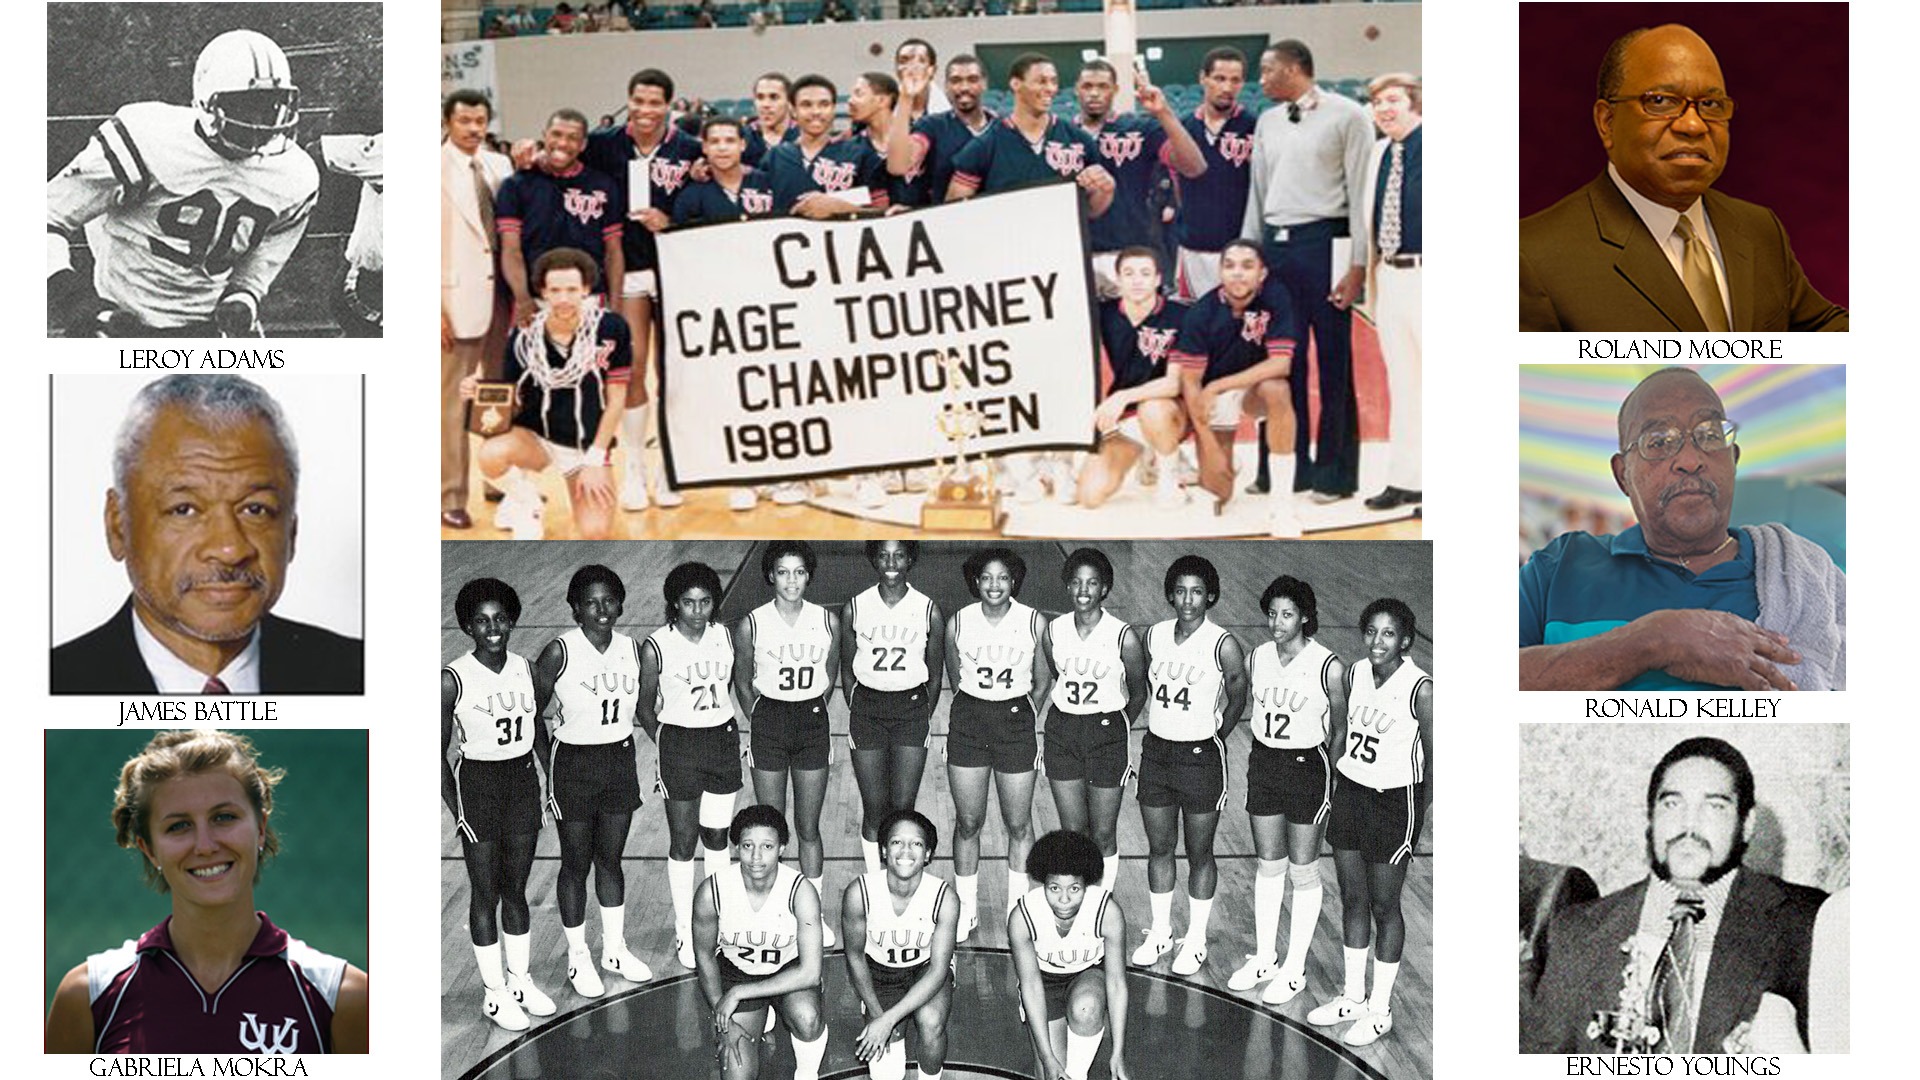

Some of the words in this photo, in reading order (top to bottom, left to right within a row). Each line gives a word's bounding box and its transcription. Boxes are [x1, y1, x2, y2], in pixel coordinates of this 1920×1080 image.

[147, 188, 280, 276] 90
[772, 219, 945, 289] CIAA
[675, 301, 801, 359] CAGE
[834, 271, 1059, 344] TOURNEY
[737, 339, 1013, 413] CHAMPIONS
[723, 416, 832, 464] 1980
[860, 625, 919, 644] VUU
[767, 643, 825, 665] VUU
[872, 647, 907, 672] 22
[965, 645, 1025, 667] VUU
[674, 661, 728, 685] VUU
[778, 666, 815, 691] 30
[976, 666, 1014, 690] 34
[1055, 657, 1111, 681] VUU
[580, 672, 635, 696] VUU
[1065, 681, 1099, 706] 32
[473, 691, 534, 717] VUU
[690, 683, 721, 712] 21
[1155, 683, 1192, 712] 44
[1254, 687, 1309, 713] VUU
[601, 698, 620, 726] 11
[495, 716, 523, 746] 31
[1264, 712, 1291, 740] 12
[1350, 731, 1380, 765] 25
[738, 945, 781, 965] 20
[887, 948, 920, 964] 10
